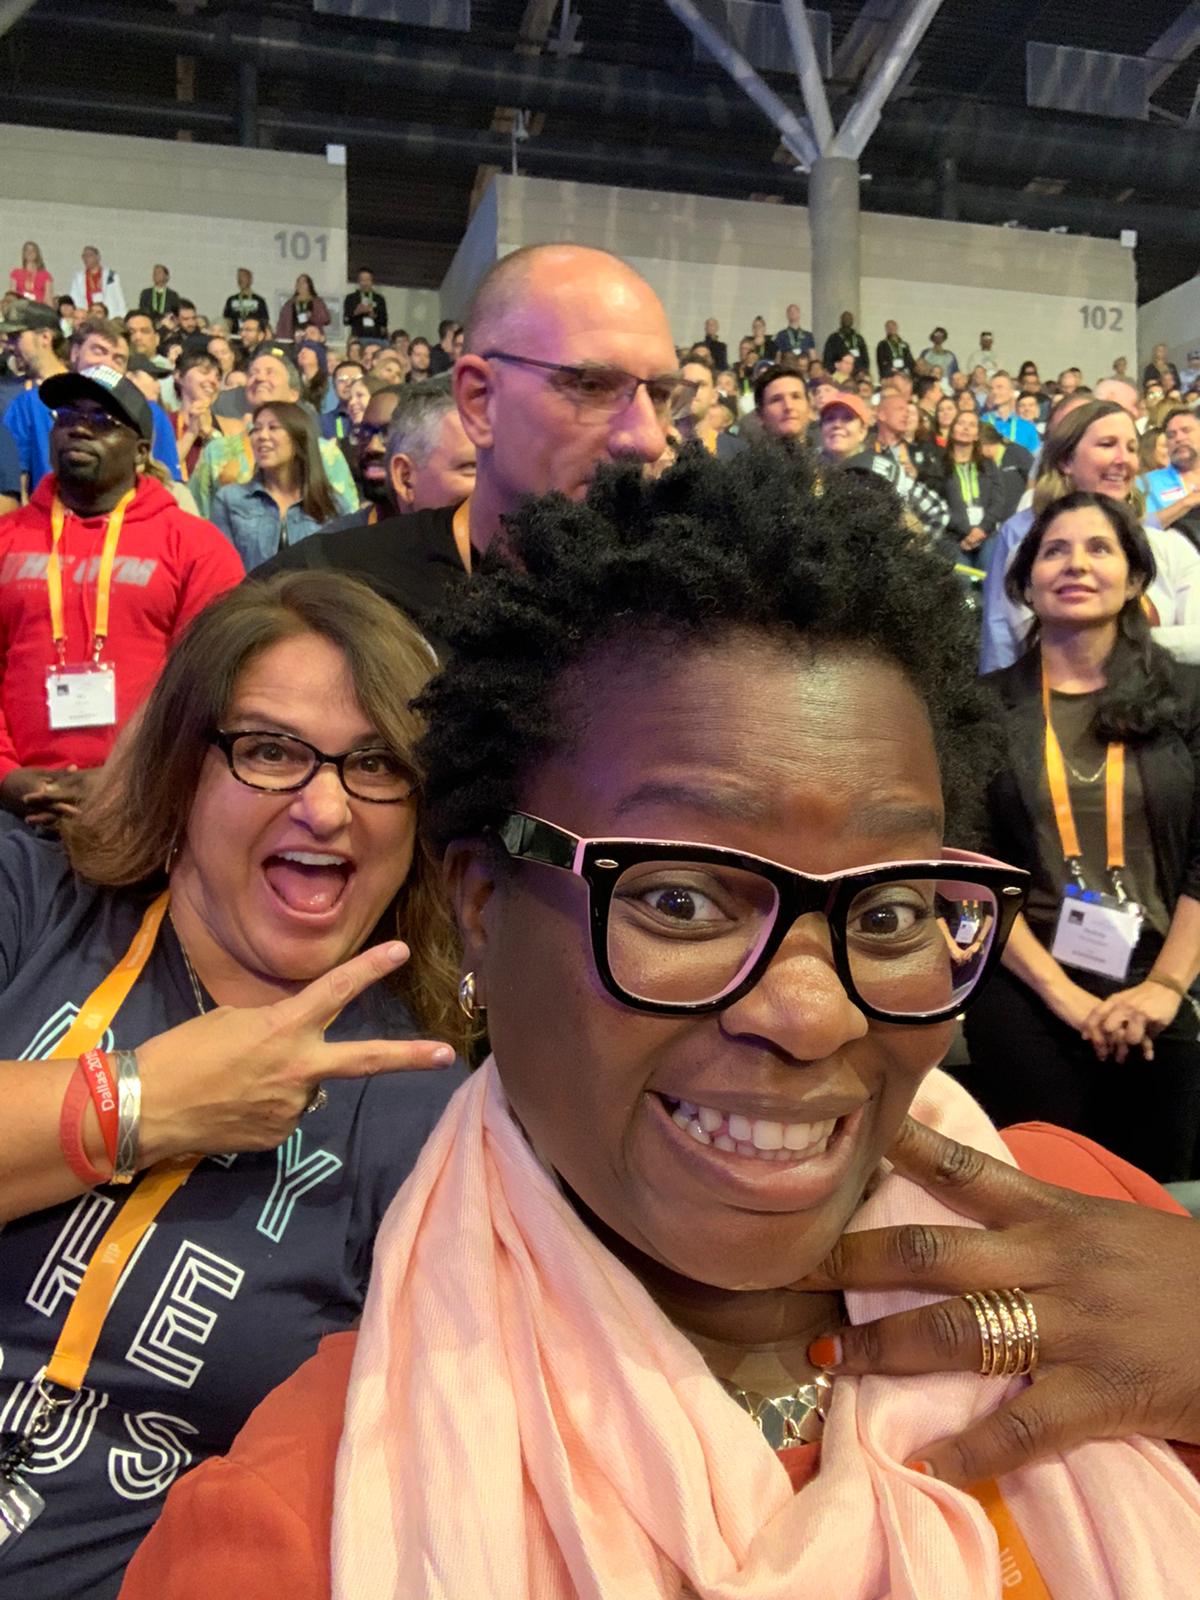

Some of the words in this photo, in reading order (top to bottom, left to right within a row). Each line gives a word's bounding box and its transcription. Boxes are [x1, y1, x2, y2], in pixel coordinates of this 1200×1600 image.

[273, 230, 328, 262] 101
[1079, 305, 1123, 331] 102
[95, 1070, 115, 1112] Dallas
[101, 1242, 121, 1265] VIP
